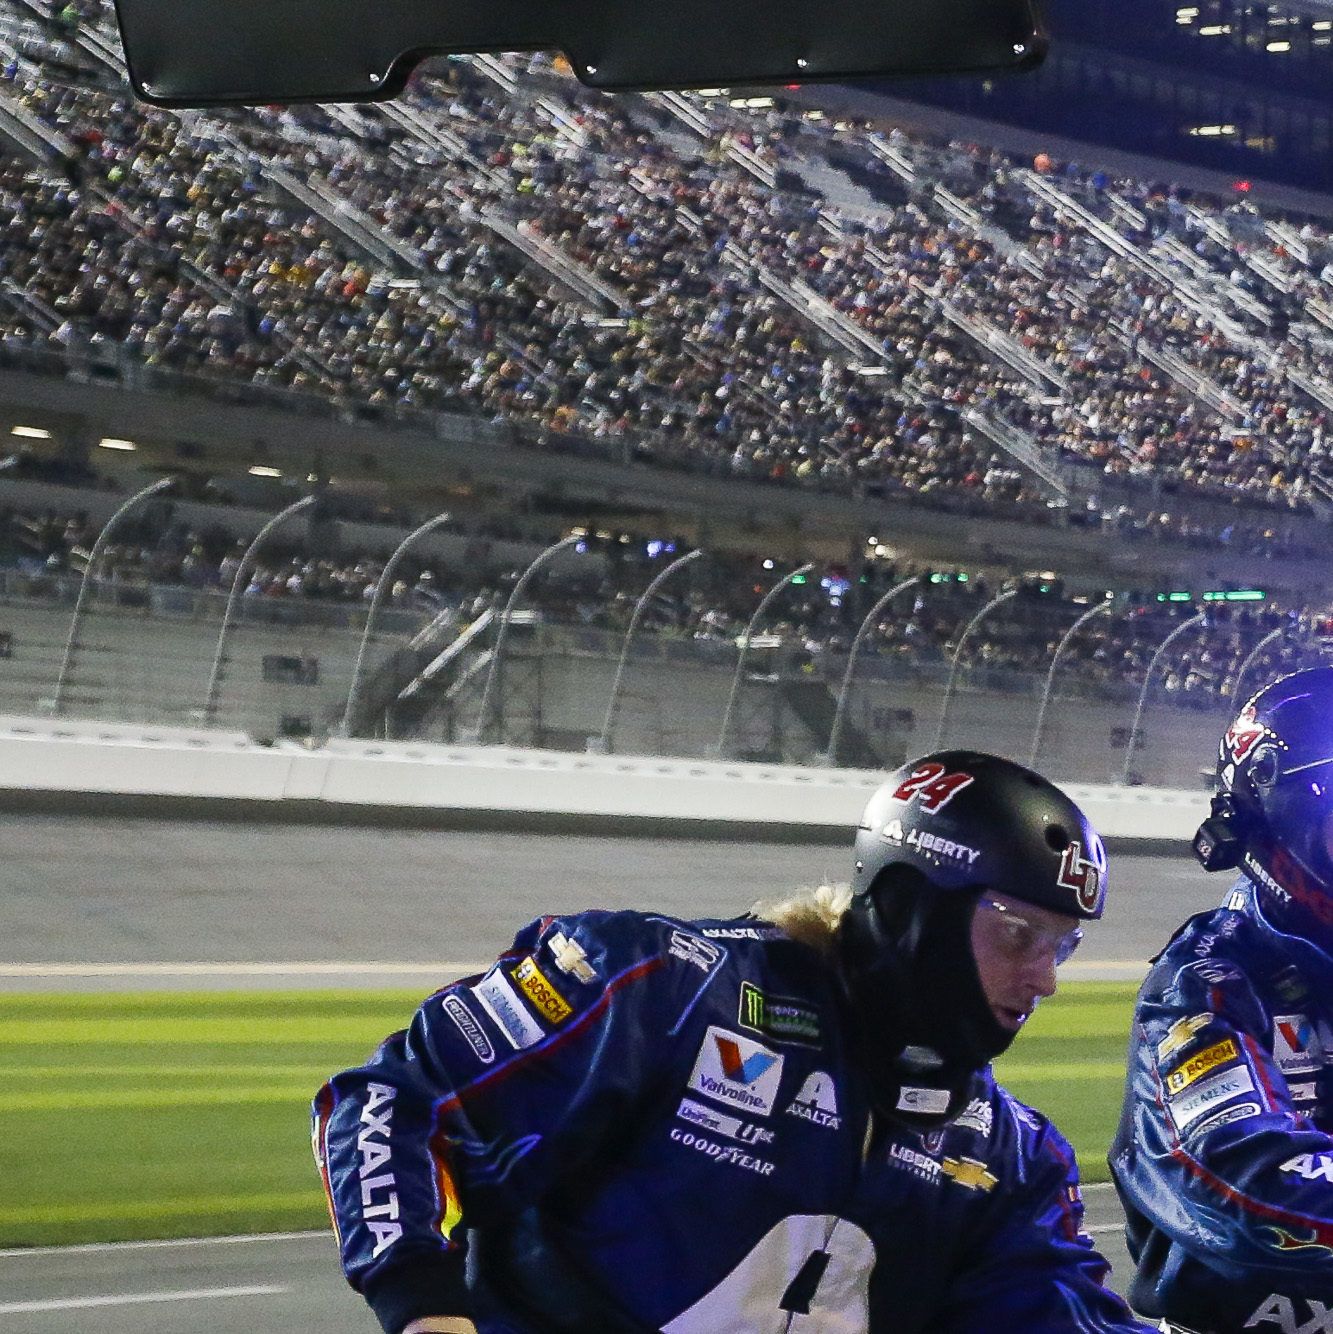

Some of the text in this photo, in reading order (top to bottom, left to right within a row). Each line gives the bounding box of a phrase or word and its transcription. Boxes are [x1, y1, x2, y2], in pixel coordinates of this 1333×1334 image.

[892, 763, 975, 814] 24
[906, 828, 981, 864] LIBERTY
[526, 975, 567, 1019] BOSCH
[1187, 1042, 1234, 1077] BOSCH
[701, 1073, 767, 1108] Valvoline
[785, 1102, 842, 1131] AXALTA
[355, 1082, 403, 1259] AXALTA
[669, 1127, 776, 1176] GOODYEAR
